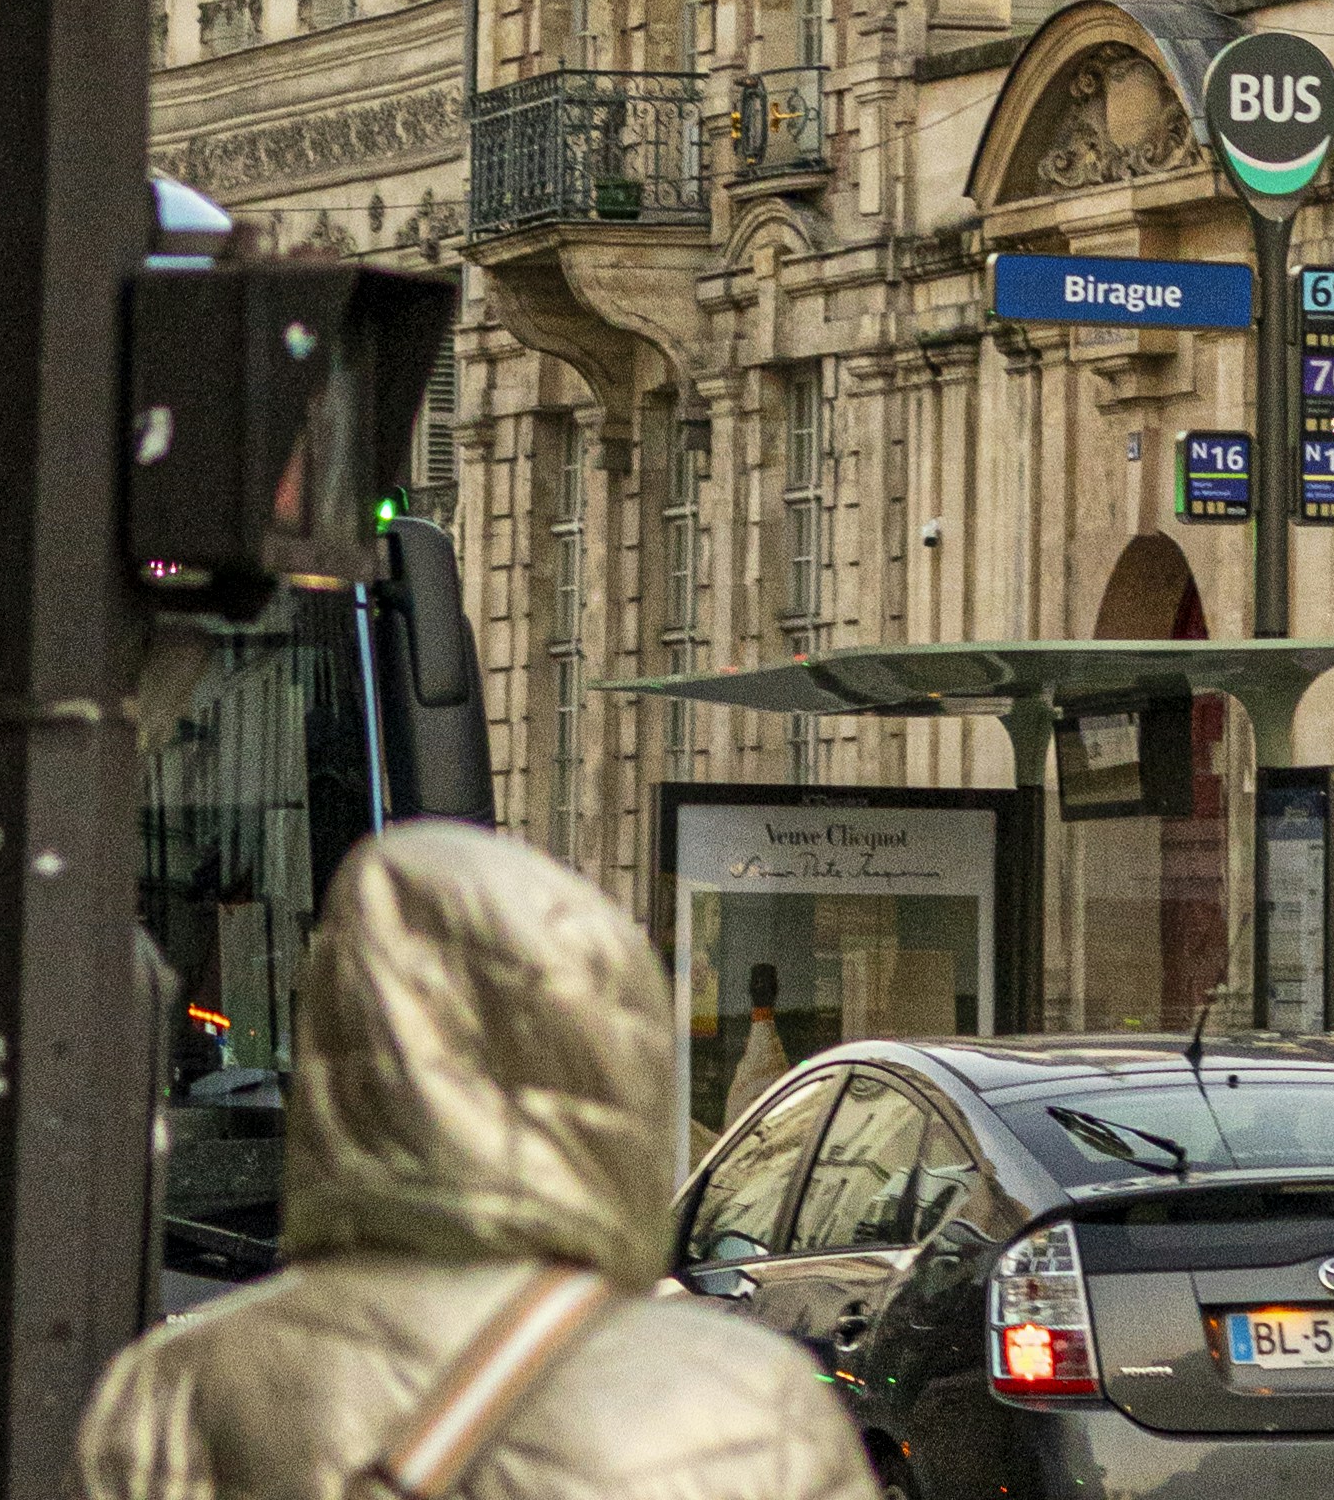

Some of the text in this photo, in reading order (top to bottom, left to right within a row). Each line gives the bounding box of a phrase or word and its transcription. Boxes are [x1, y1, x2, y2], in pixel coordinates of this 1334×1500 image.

[1230, 74, 1322, 123] BUS
[1064, 273, 1183, 312] Birague
[1191, 441, 1245, 471] N16
[766, 823, 908, 850] Veuve Clicquot
